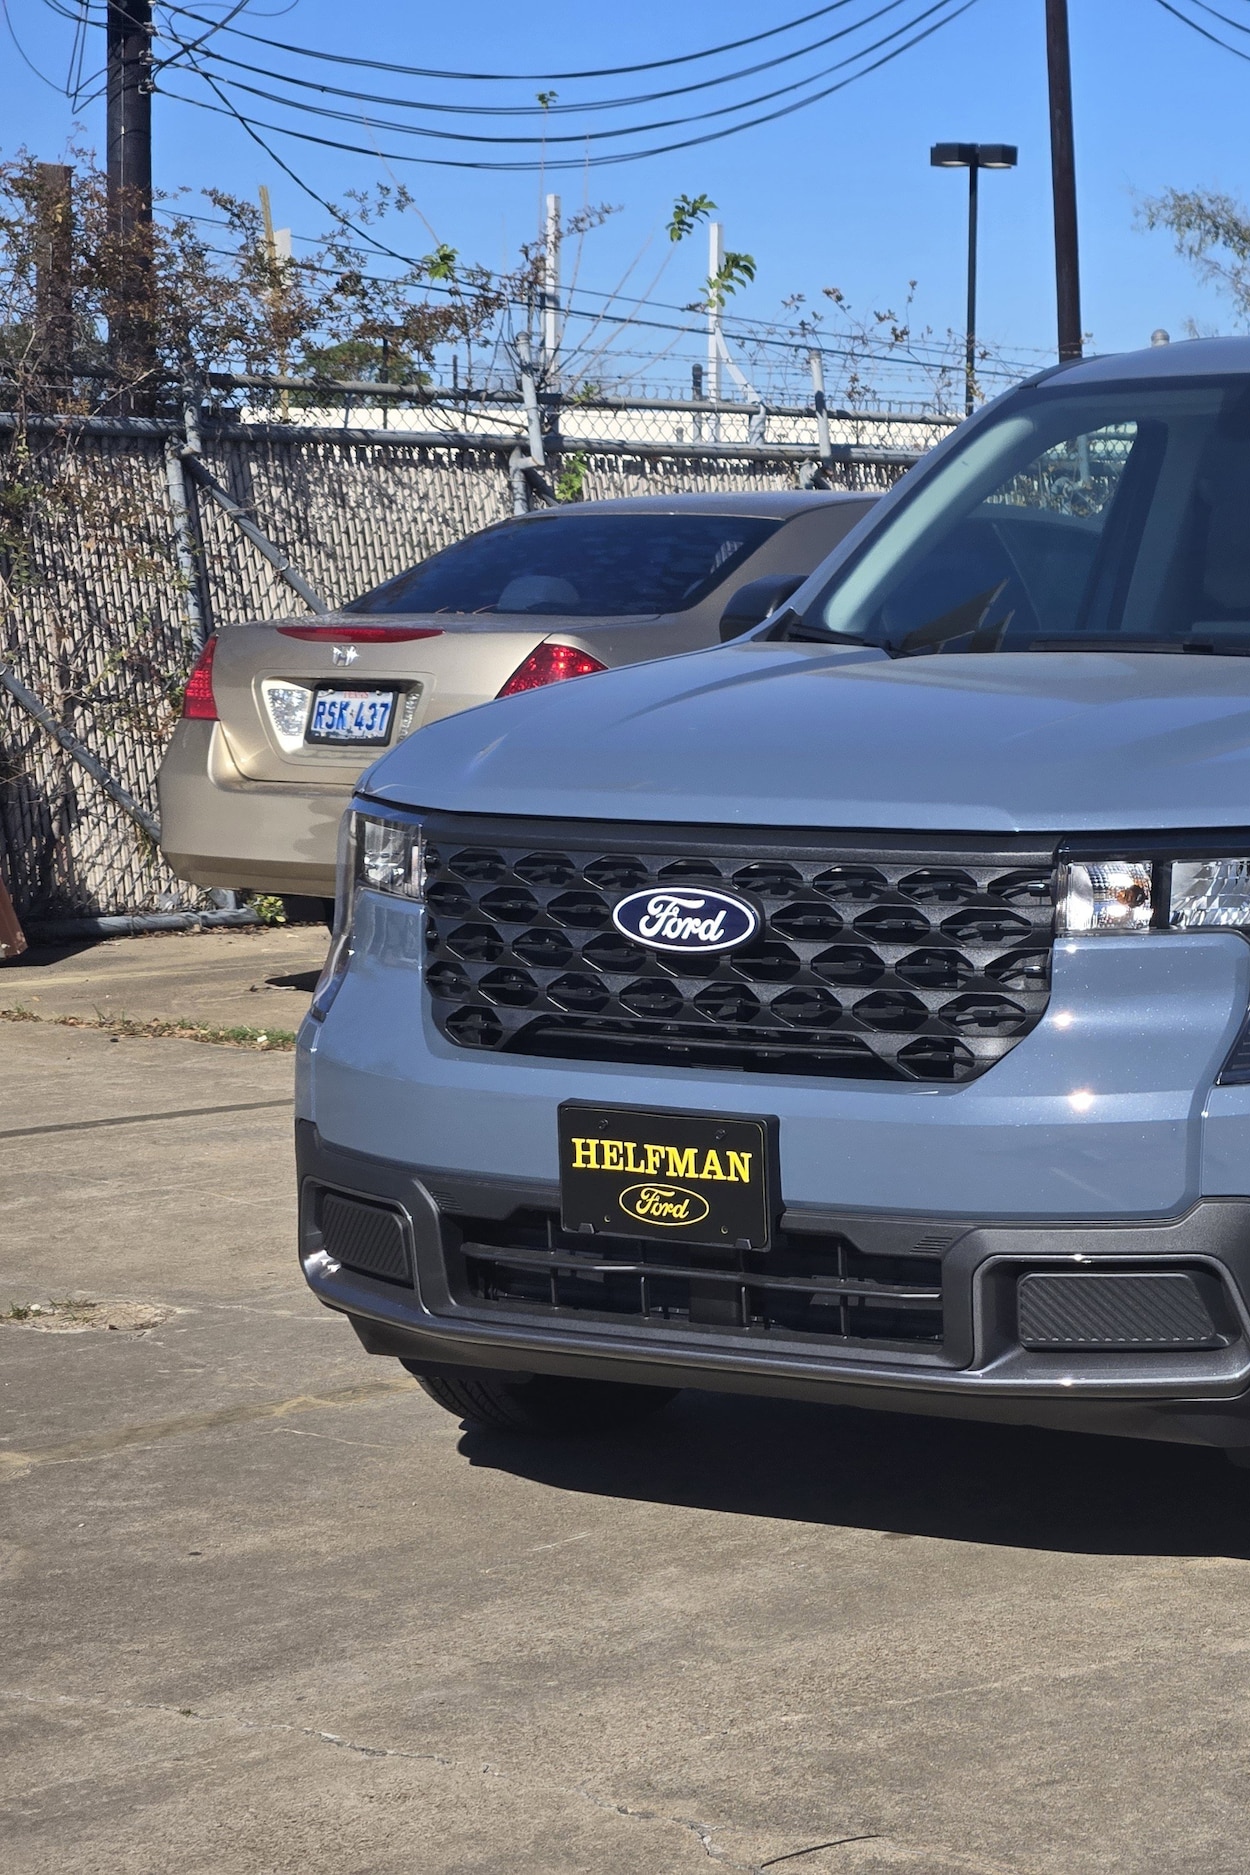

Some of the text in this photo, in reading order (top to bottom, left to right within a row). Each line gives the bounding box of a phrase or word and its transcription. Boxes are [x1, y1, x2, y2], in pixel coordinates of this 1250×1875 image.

[314, 701, 389, 731] RSK 437
[638, 895, 727, 942] Ford
[571, 1137, 752, 1183] HELFMAN
[635, 1187, 690, 1219] Ford
